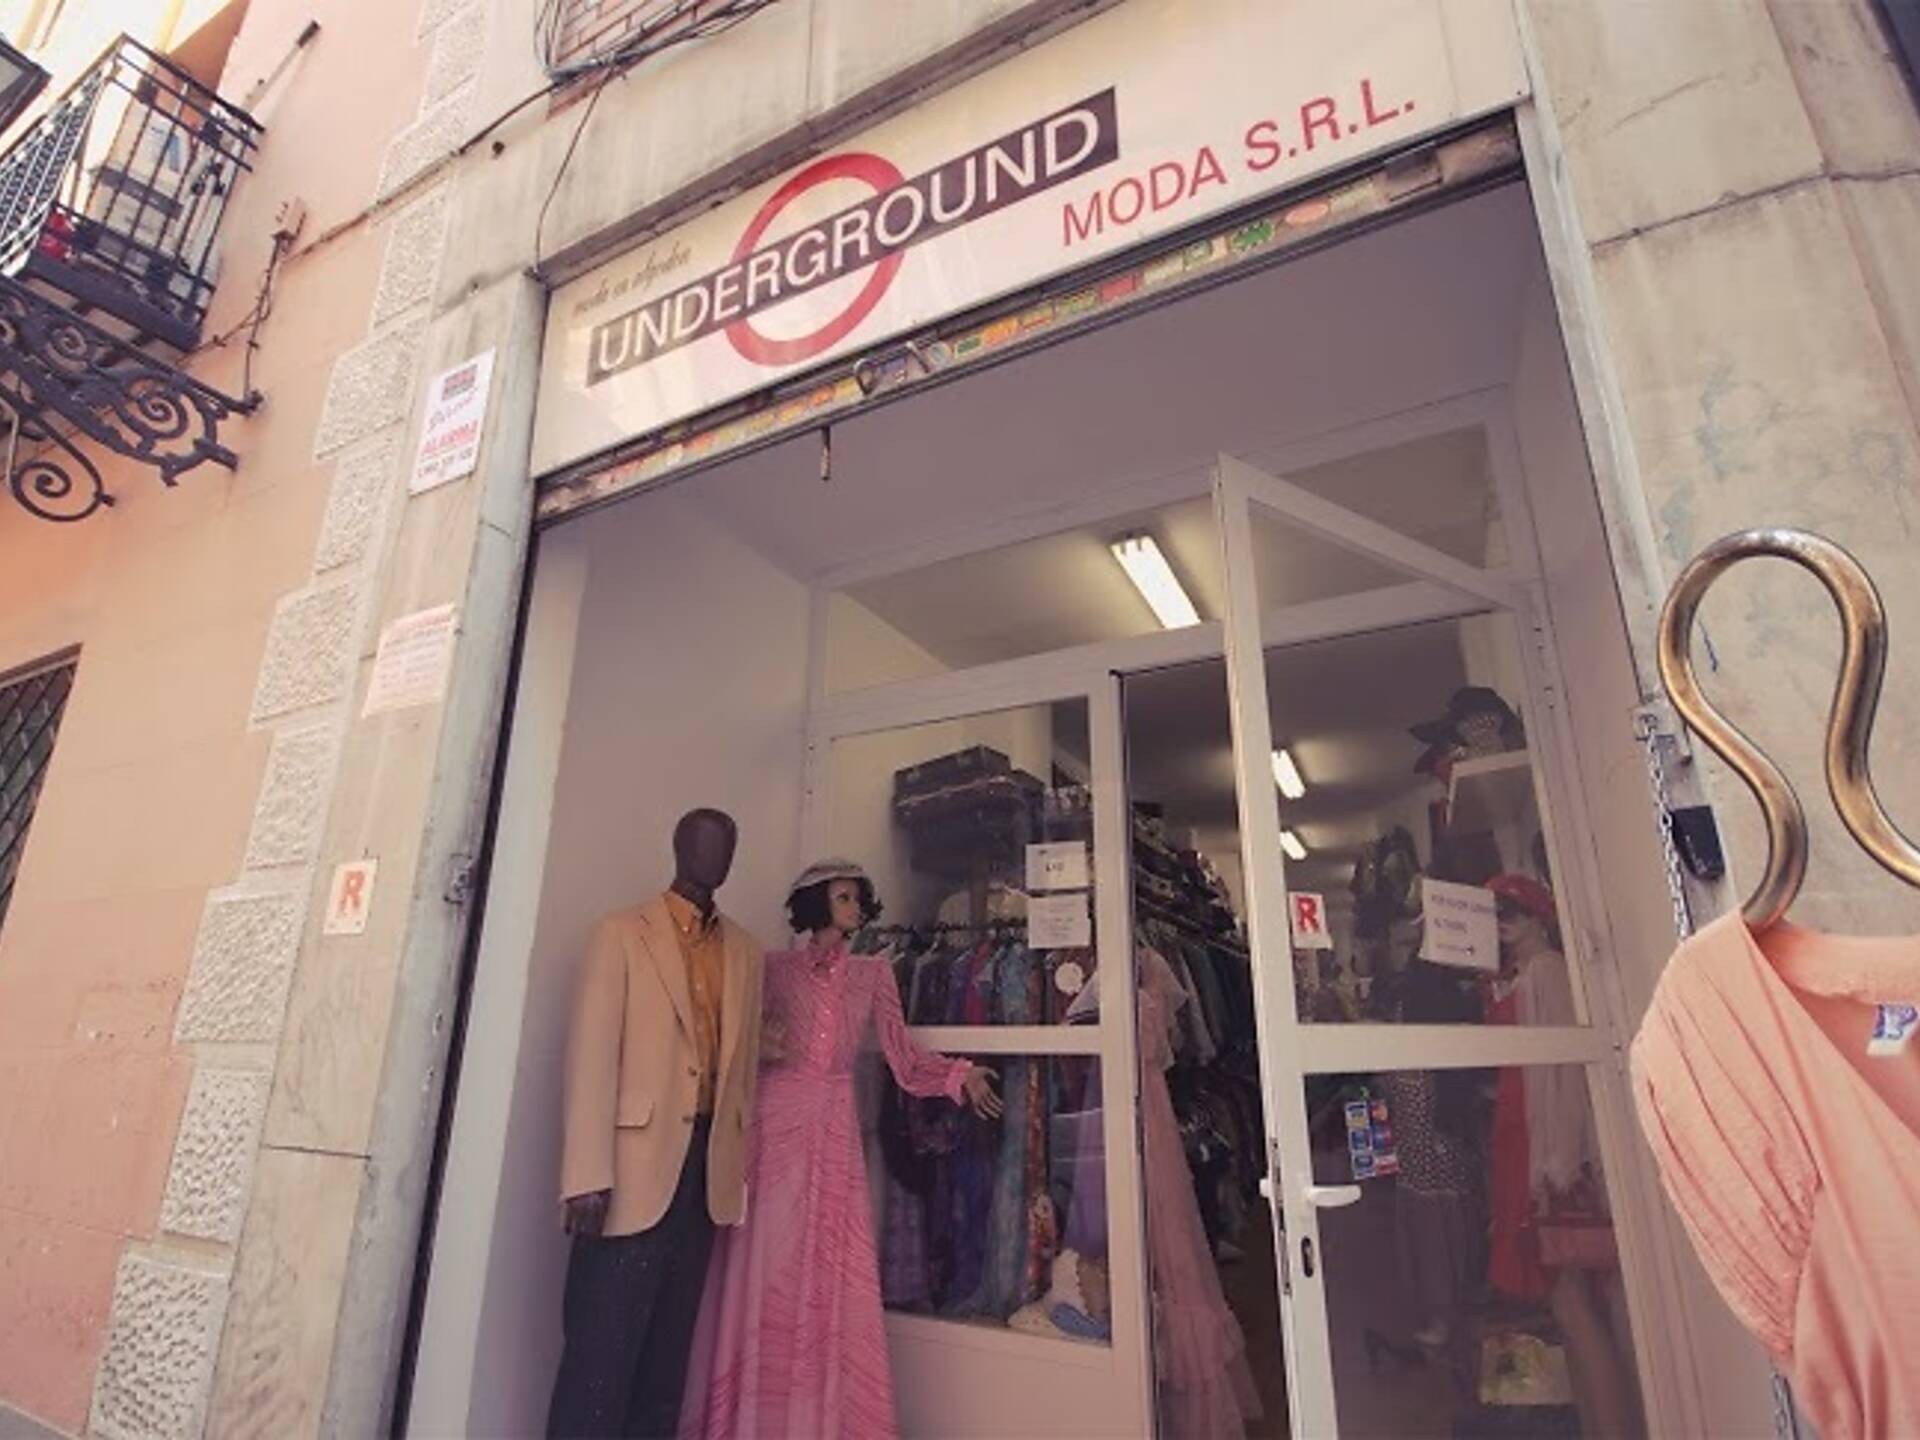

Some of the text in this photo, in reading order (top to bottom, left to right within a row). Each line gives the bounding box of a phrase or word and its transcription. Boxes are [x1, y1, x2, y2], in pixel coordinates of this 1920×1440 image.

[1061, 78, 1416, 246] MODA S.R.L.
[598, 106, 1101, 372] UNDERGROUND
[337, 869, 366, 913] R
[1295, 895, 1320, 933] R
